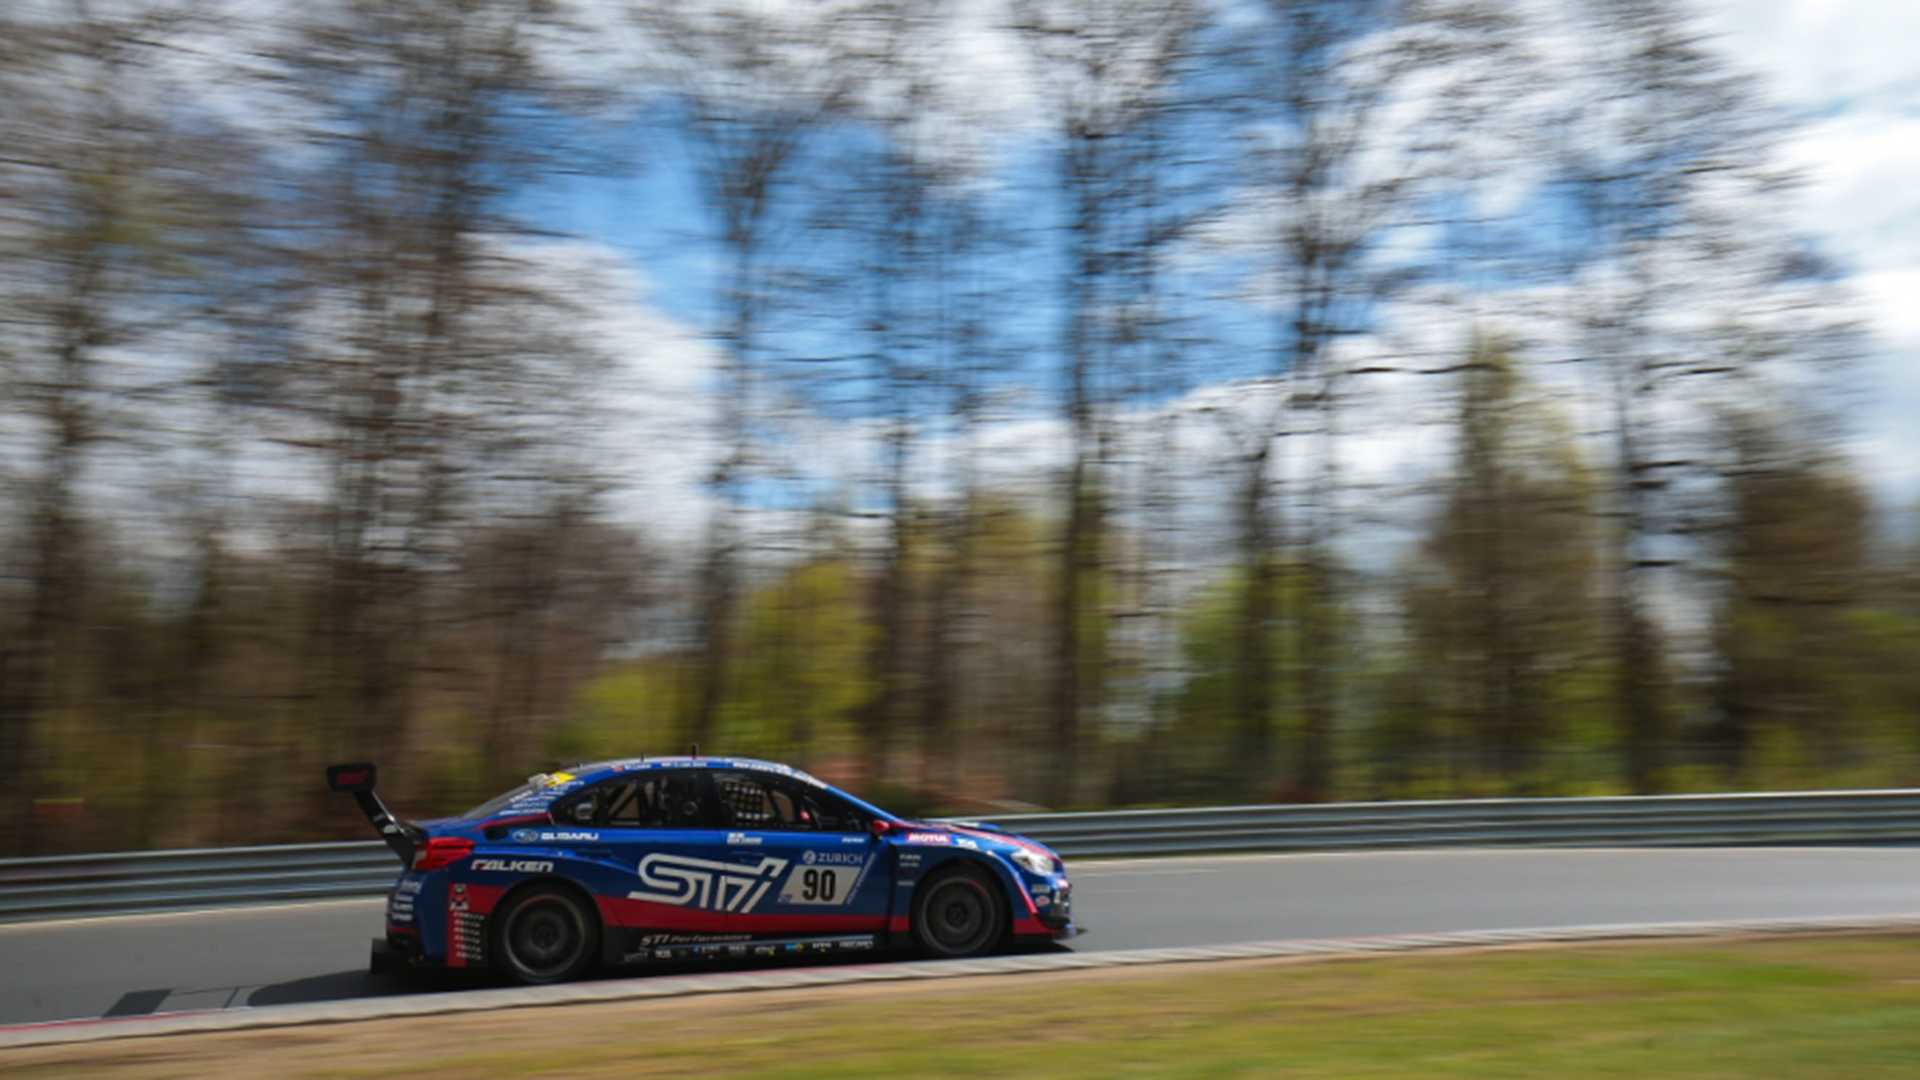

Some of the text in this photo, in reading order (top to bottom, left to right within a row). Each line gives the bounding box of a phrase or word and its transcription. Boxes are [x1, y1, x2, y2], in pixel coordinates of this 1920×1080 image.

[541, 832, 599, 841] SUBARU
[818, 852, 864, 864] ZURICH
[471, 859, 554, 872] FALKEN
[802, 869, 836, 901] 90
